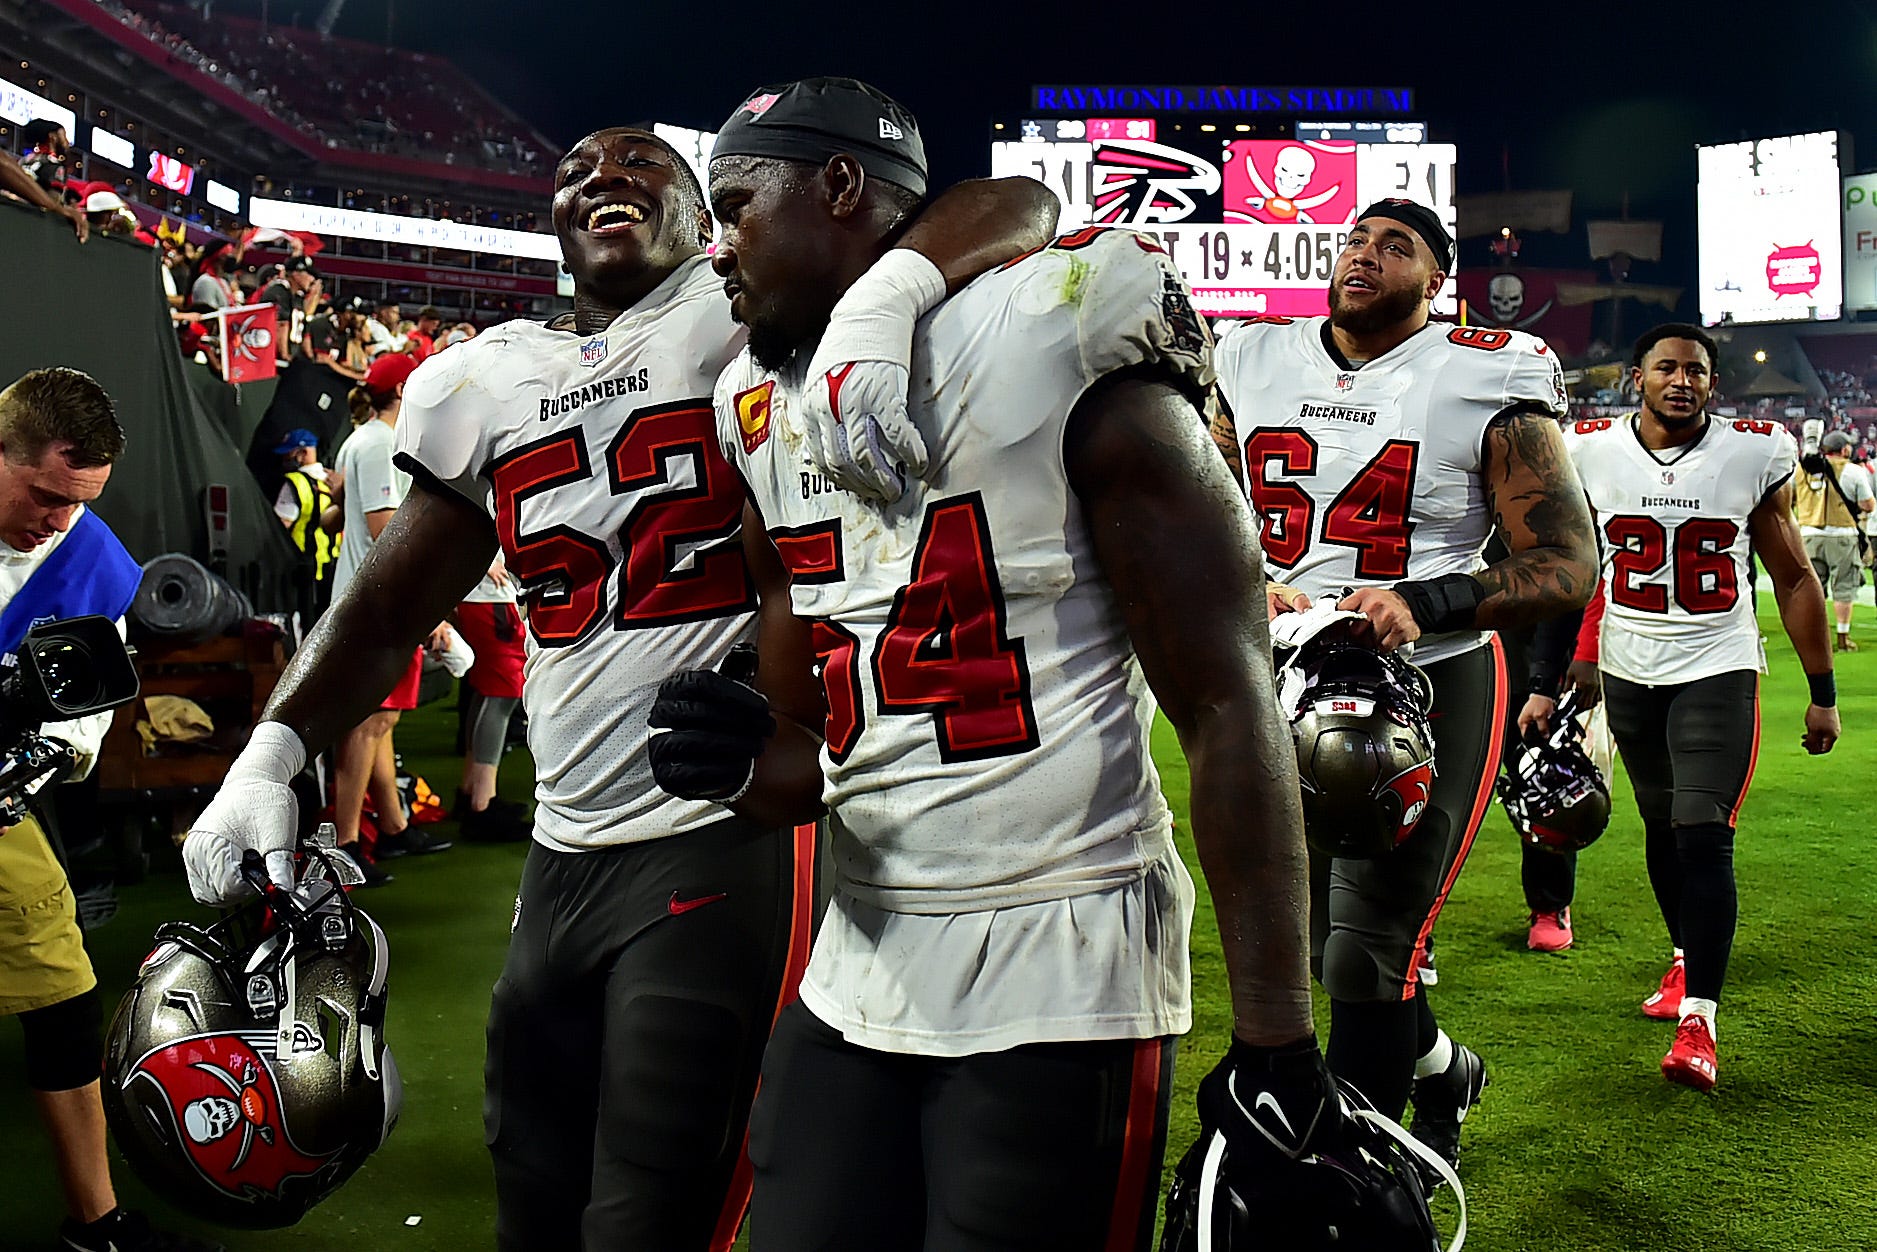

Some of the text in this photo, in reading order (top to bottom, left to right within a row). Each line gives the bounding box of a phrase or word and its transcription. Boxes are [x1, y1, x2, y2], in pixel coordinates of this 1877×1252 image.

[1038, 88, 1411, 112] RAYMOND JAMES STADIUM
[1199, 231, 1230, 281] 19
[584, 348, 602, 361] NFL
[539, 367, 649, 422] BUCCANEERS
[738, 387, 768, 434] C
[1299, 403, 1377, 426] BUCCANEERS
[481, 397, 760, 649] 52
[1244, 426, 1420, 581] 64
[1641, 496, 1700, 510] BUCCANEERS
[1603, 514, 1739, 616] 26
[766, 490, 1041, 766] 54
[1, 652, 19, 668] NF
